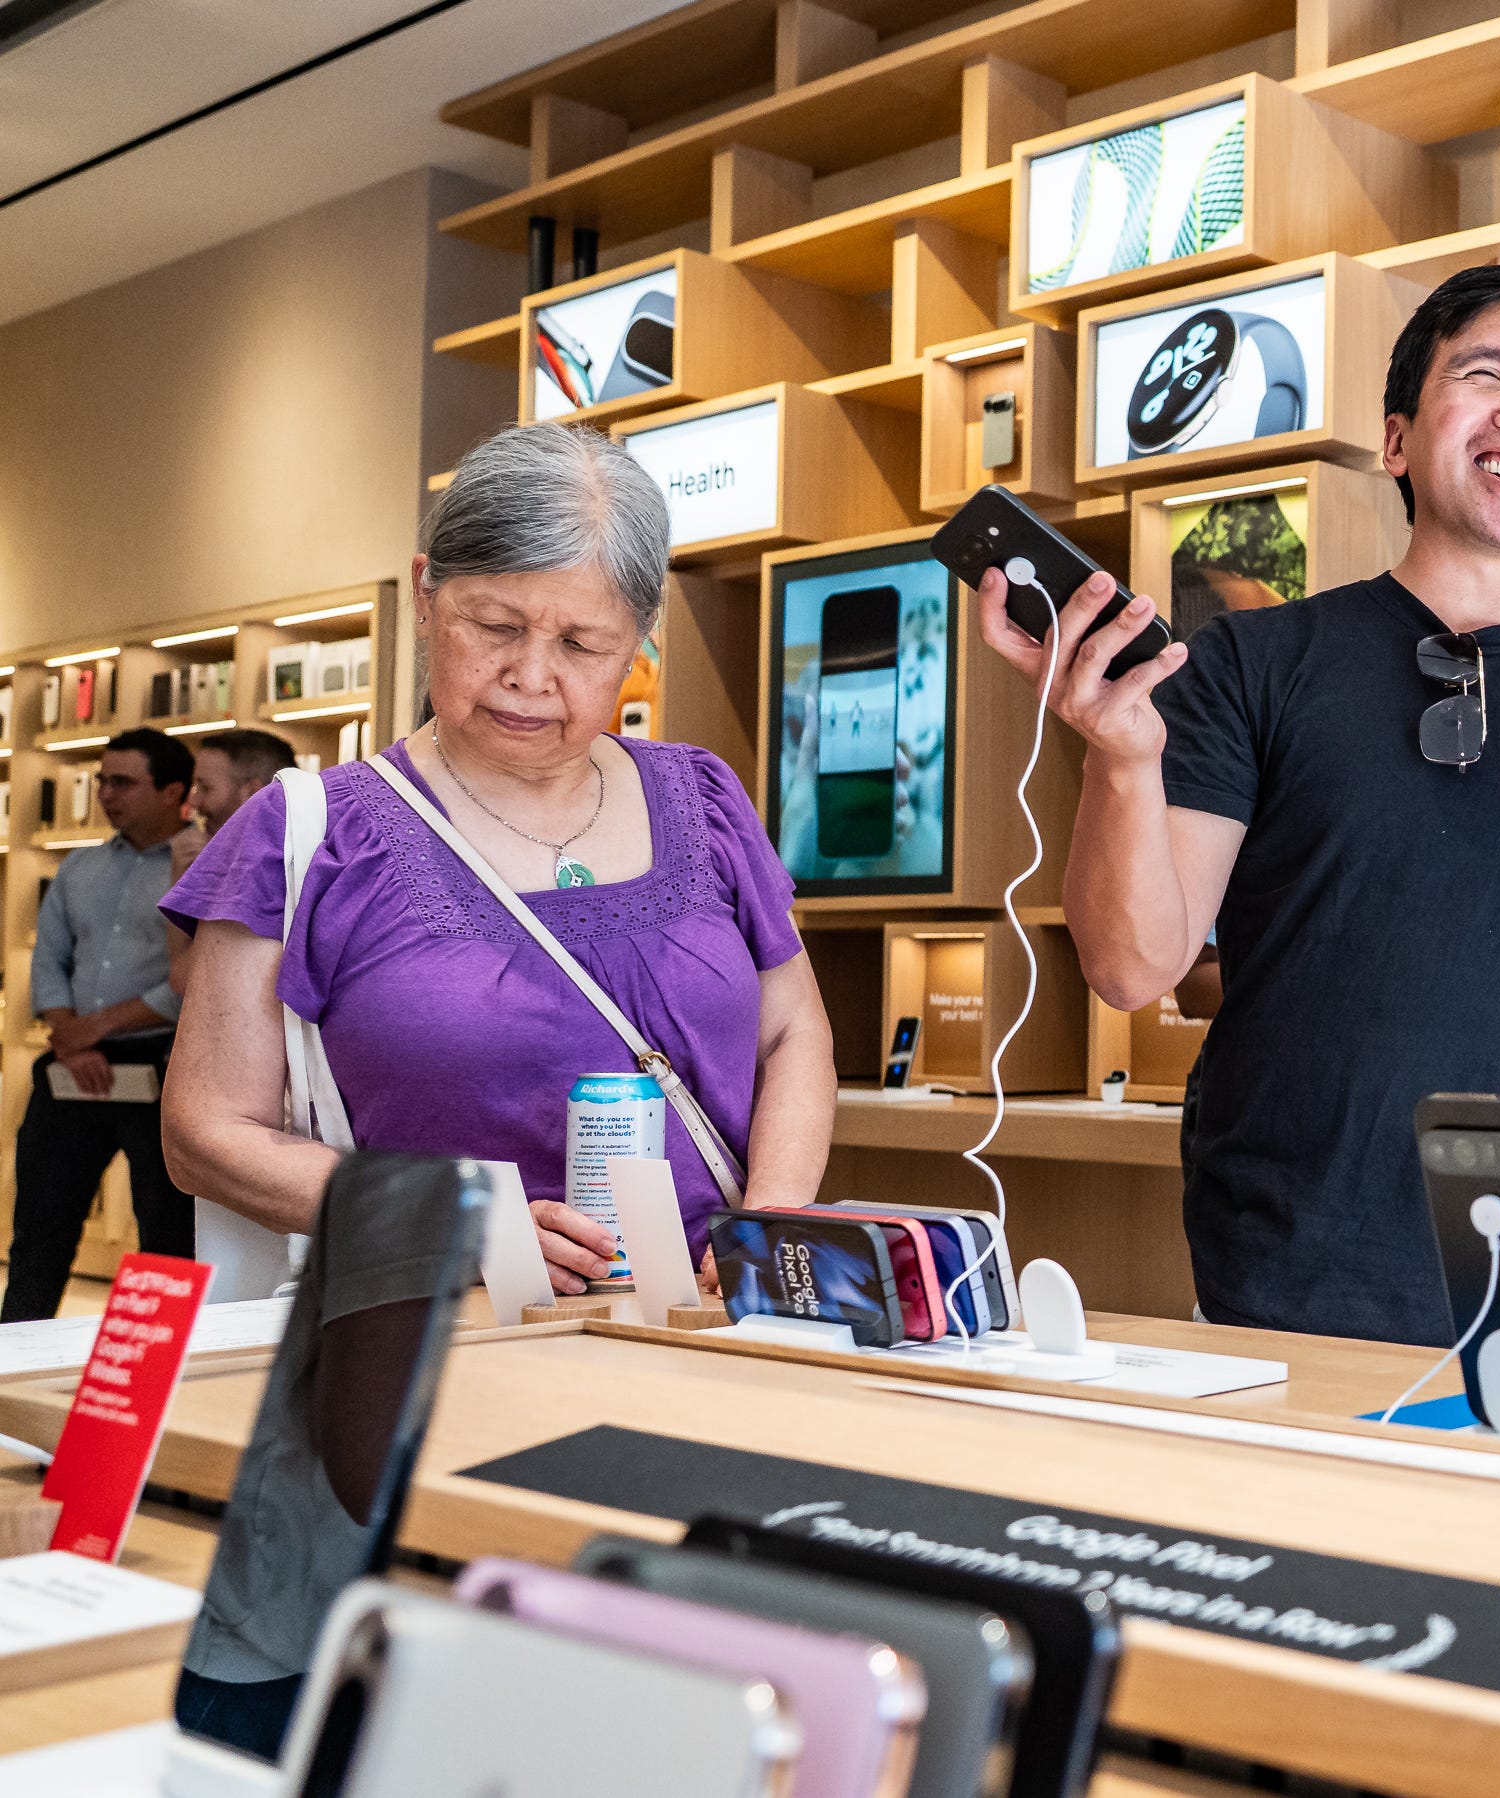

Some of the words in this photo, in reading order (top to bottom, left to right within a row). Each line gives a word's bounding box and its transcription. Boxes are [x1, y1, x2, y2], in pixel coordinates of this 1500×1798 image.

[668, 460, 735, 498] Health
[781, 1243, 802, 1288] Pixel
[793, 1291, 806, 1316] 9a
[795, 1244, 820, 1317] Google
[888, 1531, 1080, 1586] Smartphone
[1106, 1573, 1207, 1616] Years
[1196, 1593, 1247, 1624] in
[1005, 1514, 1160, 1562] Google
[1150, 1540, 1275, 1582] Pixel
